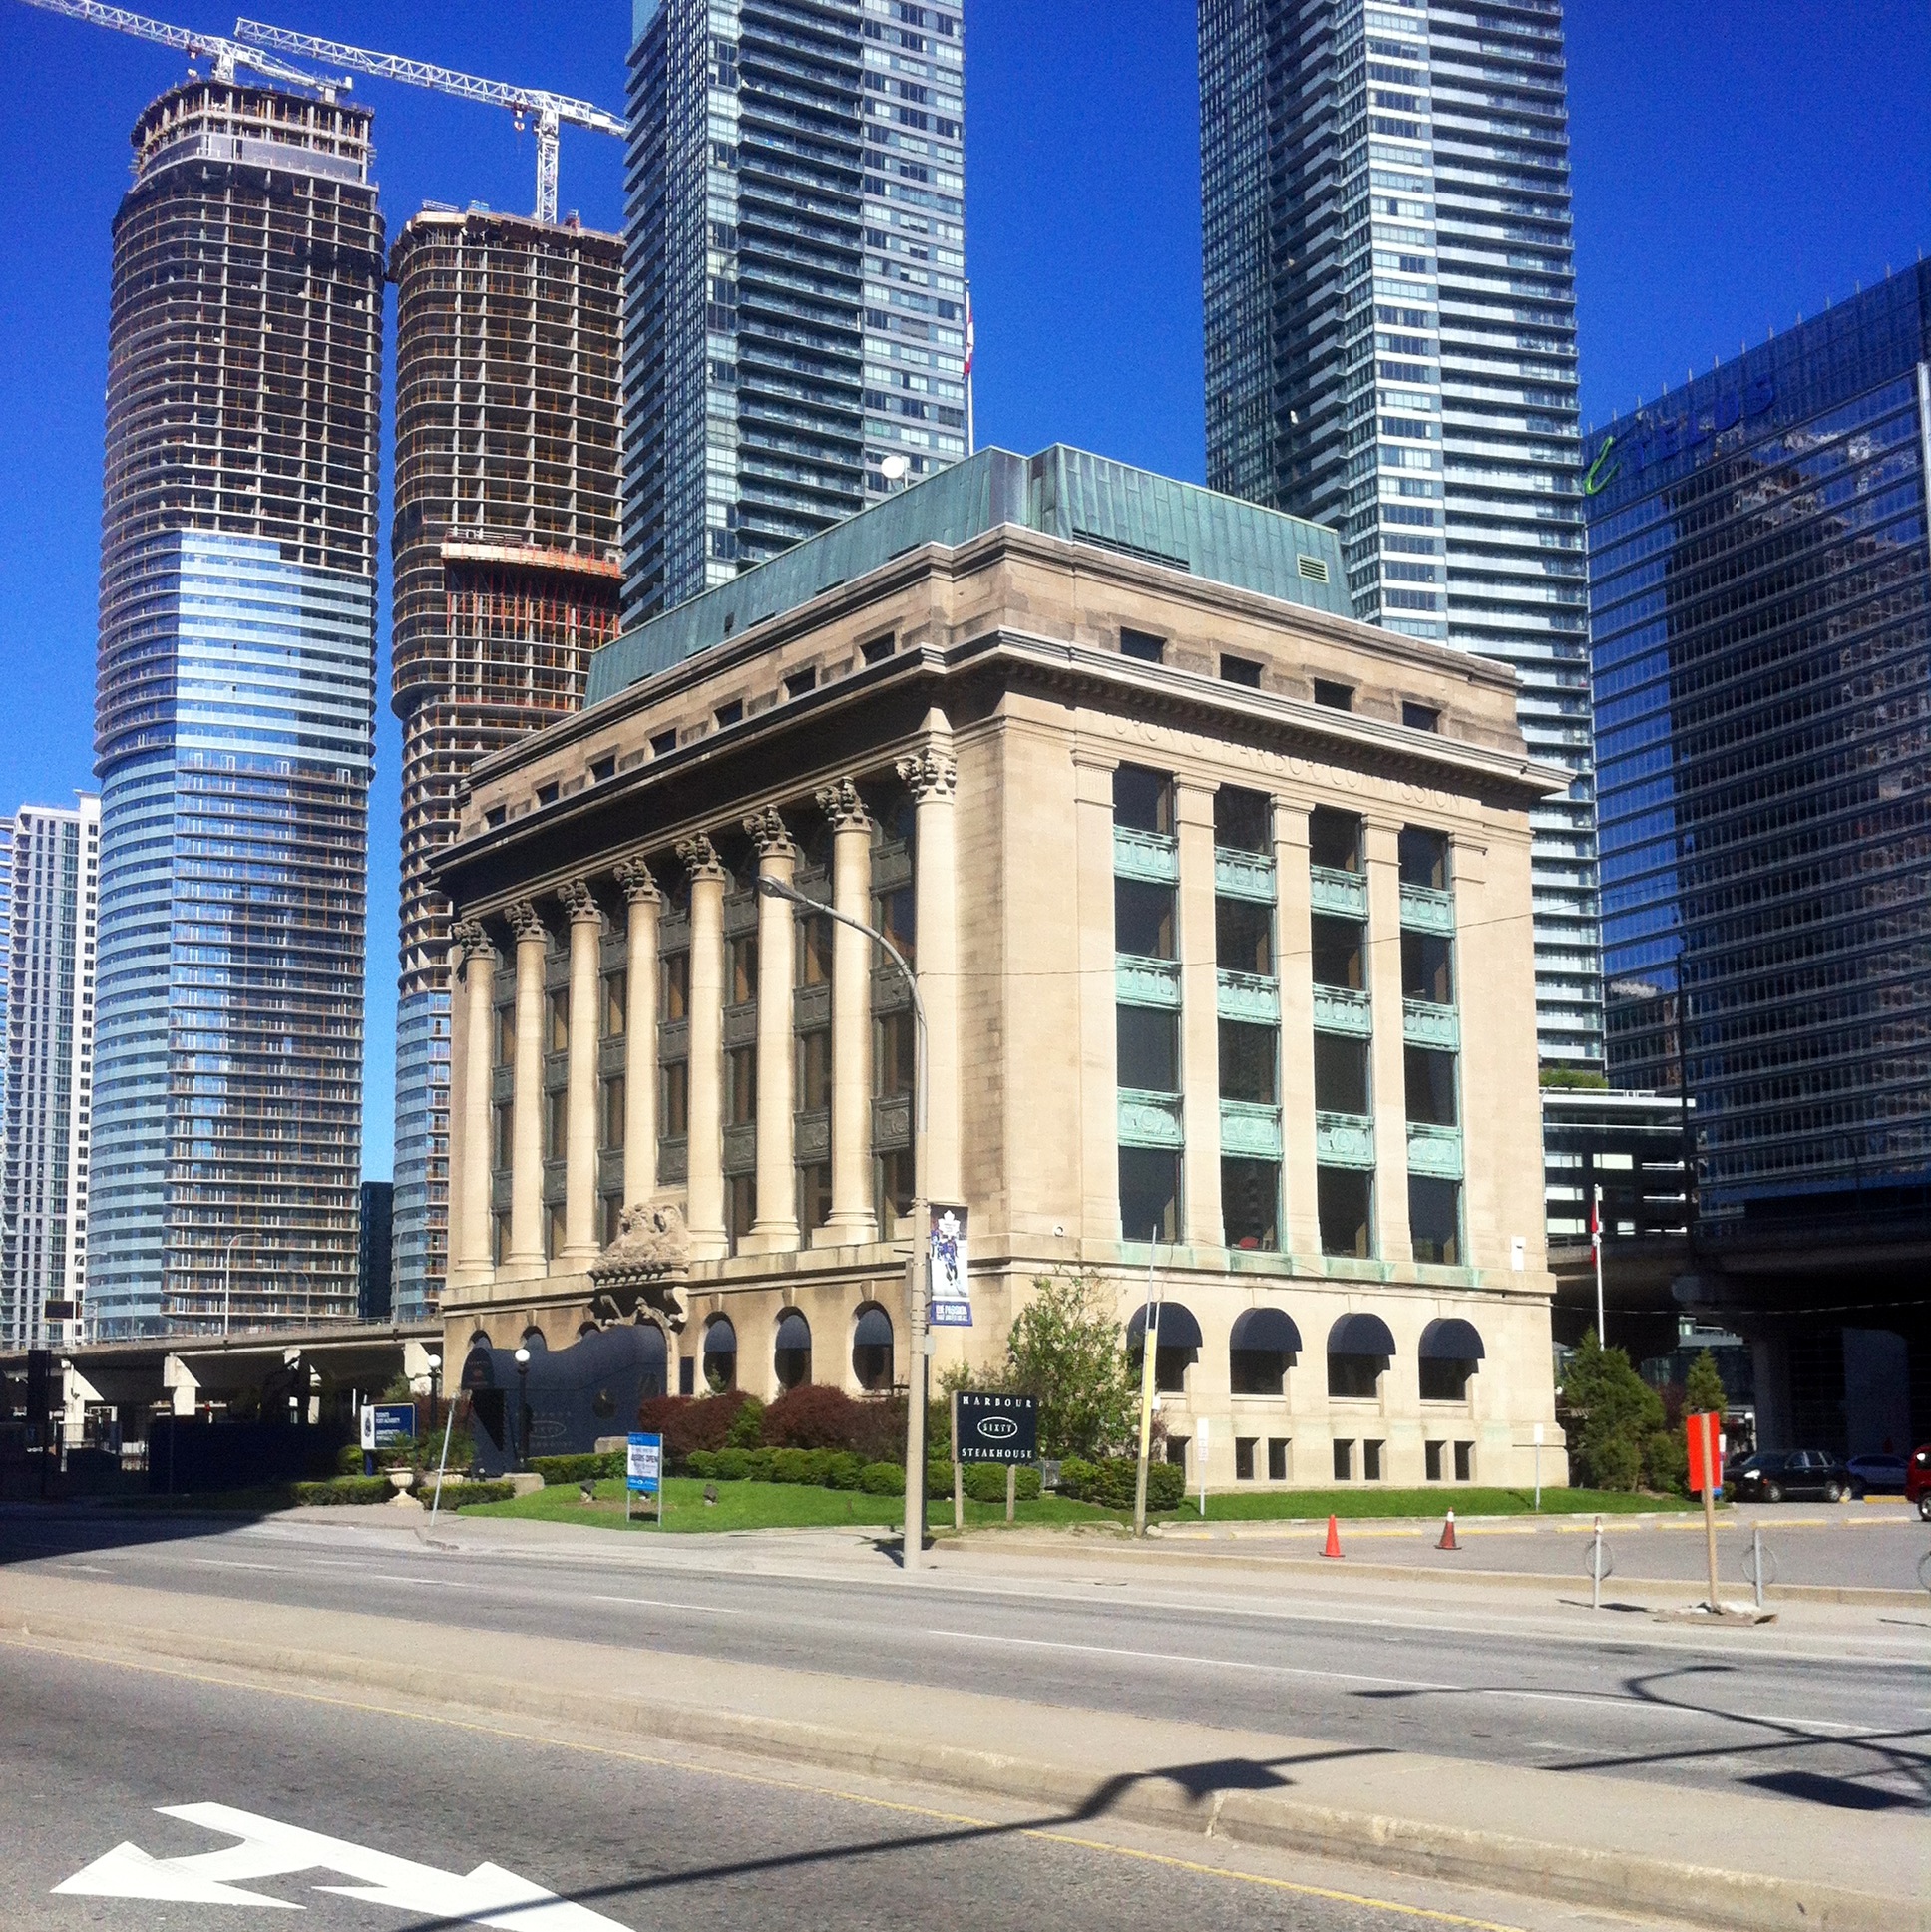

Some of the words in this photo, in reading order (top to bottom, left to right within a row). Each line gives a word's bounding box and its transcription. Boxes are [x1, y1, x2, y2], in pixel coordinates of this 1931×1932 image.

[963, 1396, 1032, 1408] HARBOUR
[982, 1423, 1012, 1432] SIXTY
[962, 1448, 1032, 1458] STEAKHOUSE
